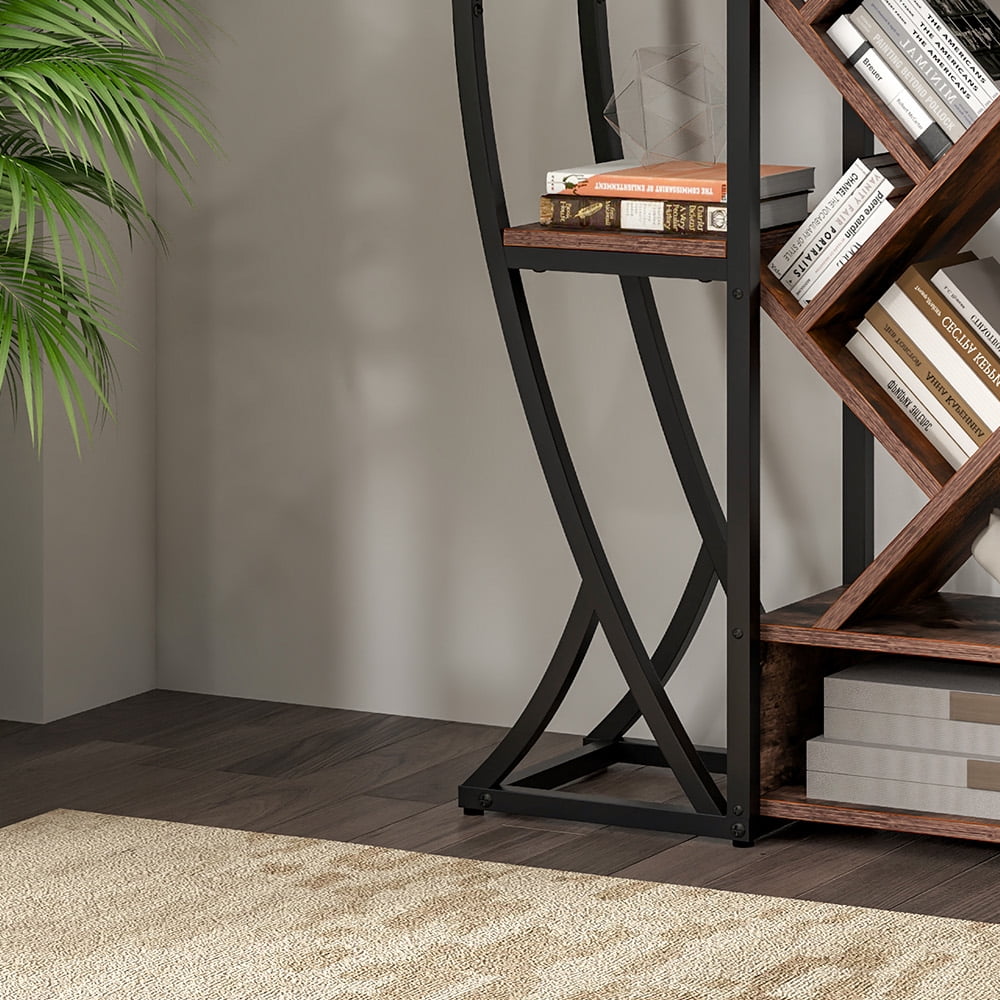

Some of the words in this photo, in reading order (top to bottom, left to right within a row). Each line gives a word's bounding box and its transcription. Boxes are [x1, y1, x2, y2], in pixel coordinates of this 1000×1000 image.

[920, 22, 934, 39] THE
[935, 42, 978, 91] AMERICANS
[928, 14, 941, 31] THE
[942, 34, 986, 83] AMERICANS
[863, 58, 882, 80] Breuer
[913, 30, 926, 47] THE
[928, 50, 970, 99] AMERICANS
[873, 34, 903, 69] PAINTING
[901, 67, 927, 97] BEYOND
[925, 96, 955, 131] POLLOCK
[700, 187, 714, 195] THE
[836, 173, 858, 197] CHANEL
[854, 174, 880, 205] VANITY
[828, 196, 839, 208] THE
[864, 190, 884, 215] pierre
[800, 206, 831, 240] VOCABULARY
[835, 204, 854, 225] FAIR
[845, 215, 865, 238] cardin
[783, 244, 798, 261] STYLE
[792, 226, 836, 278] PORTRAITS
[795, 237, 804, 247] OF
